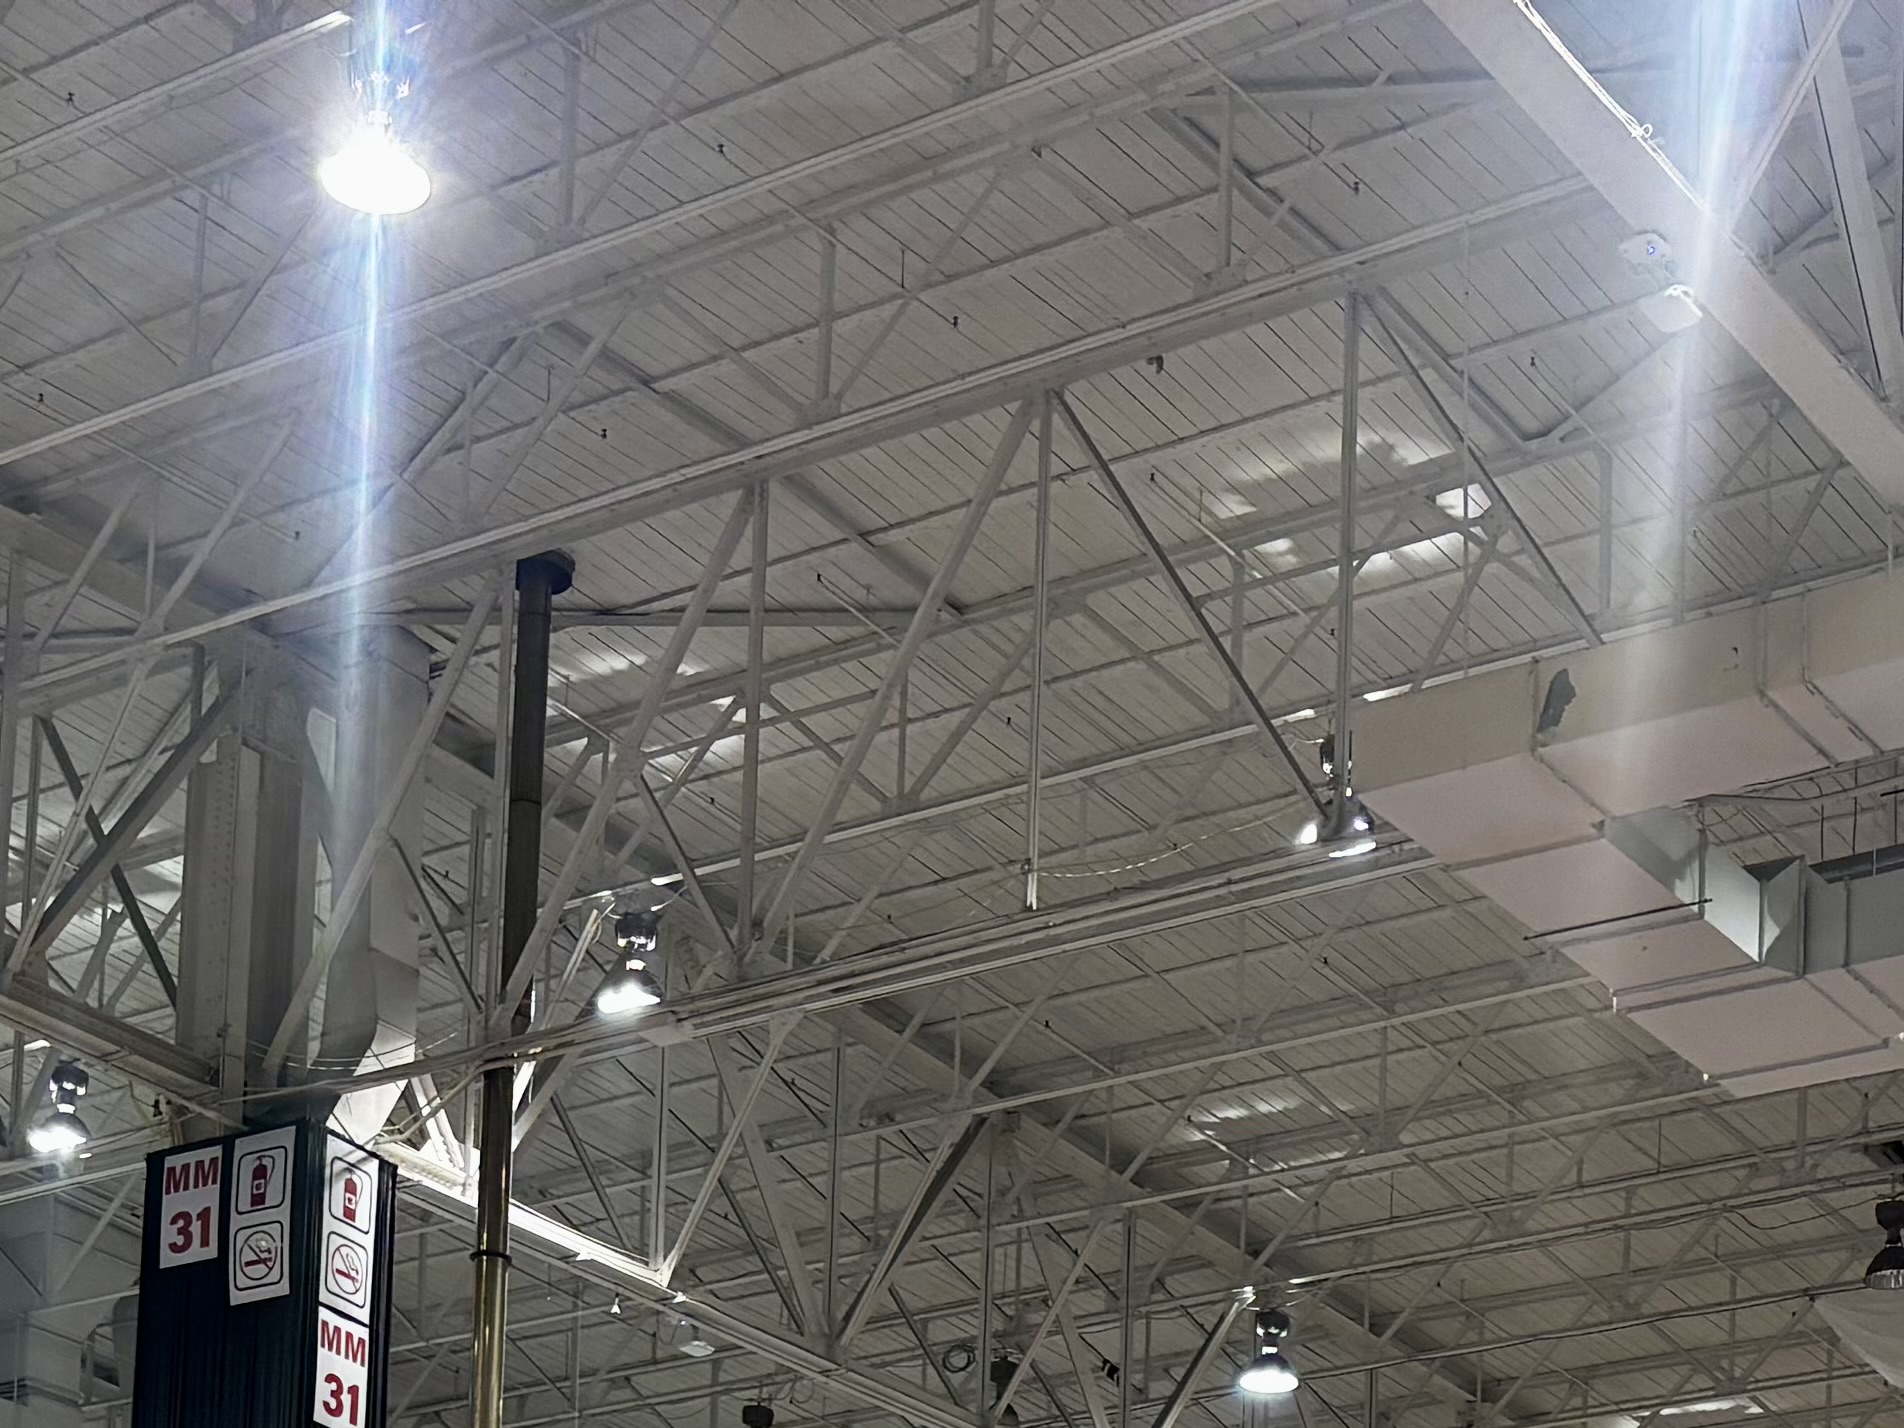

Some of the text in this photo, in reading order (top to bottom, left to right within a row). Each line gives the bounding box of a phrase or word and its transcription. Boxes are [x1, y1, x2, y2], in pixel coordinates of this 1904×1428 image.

[165, 1156, 219, 1195] MM
[168, 1206, 212, 1254] 31
[320, 1320, 366, 1367] MM
[323, 1373, 359, 1426] 31
